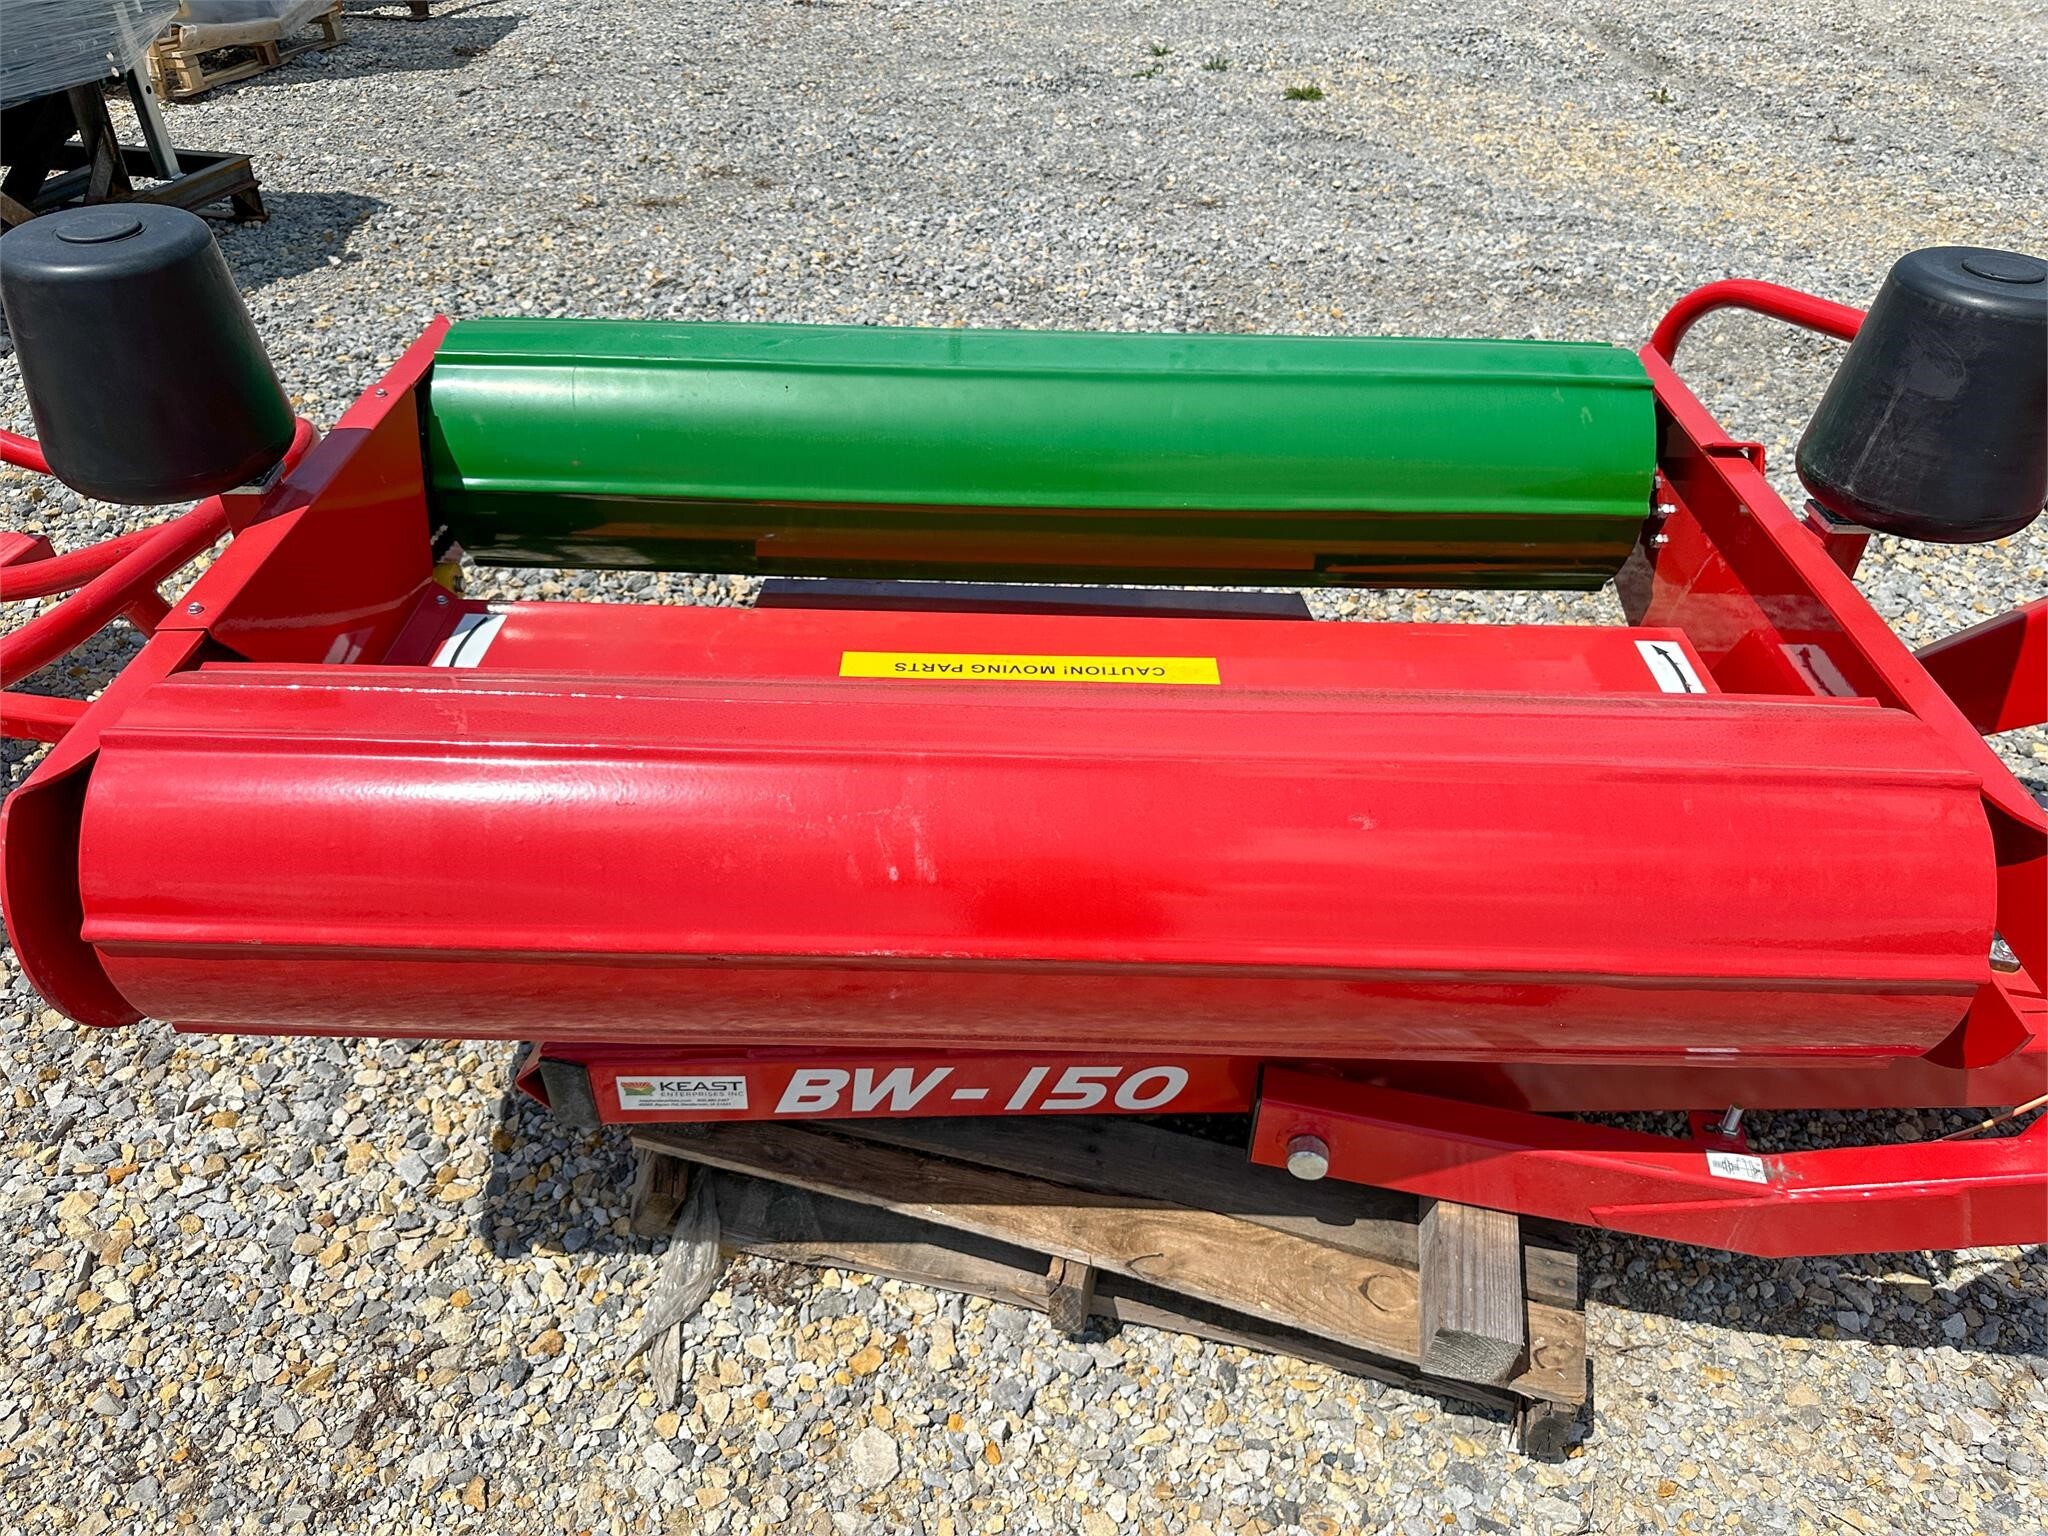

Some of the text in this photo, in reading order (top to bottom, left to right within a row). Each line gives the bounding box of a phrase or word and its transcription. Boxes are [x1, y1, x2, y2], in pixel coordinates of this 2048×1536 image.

[894, 662, 1166, 677] CAUTION! MOVING PARTS
[660, 1081, 743, 1091] KEAST
[774, 1066, 1189, 1114] BW-150
